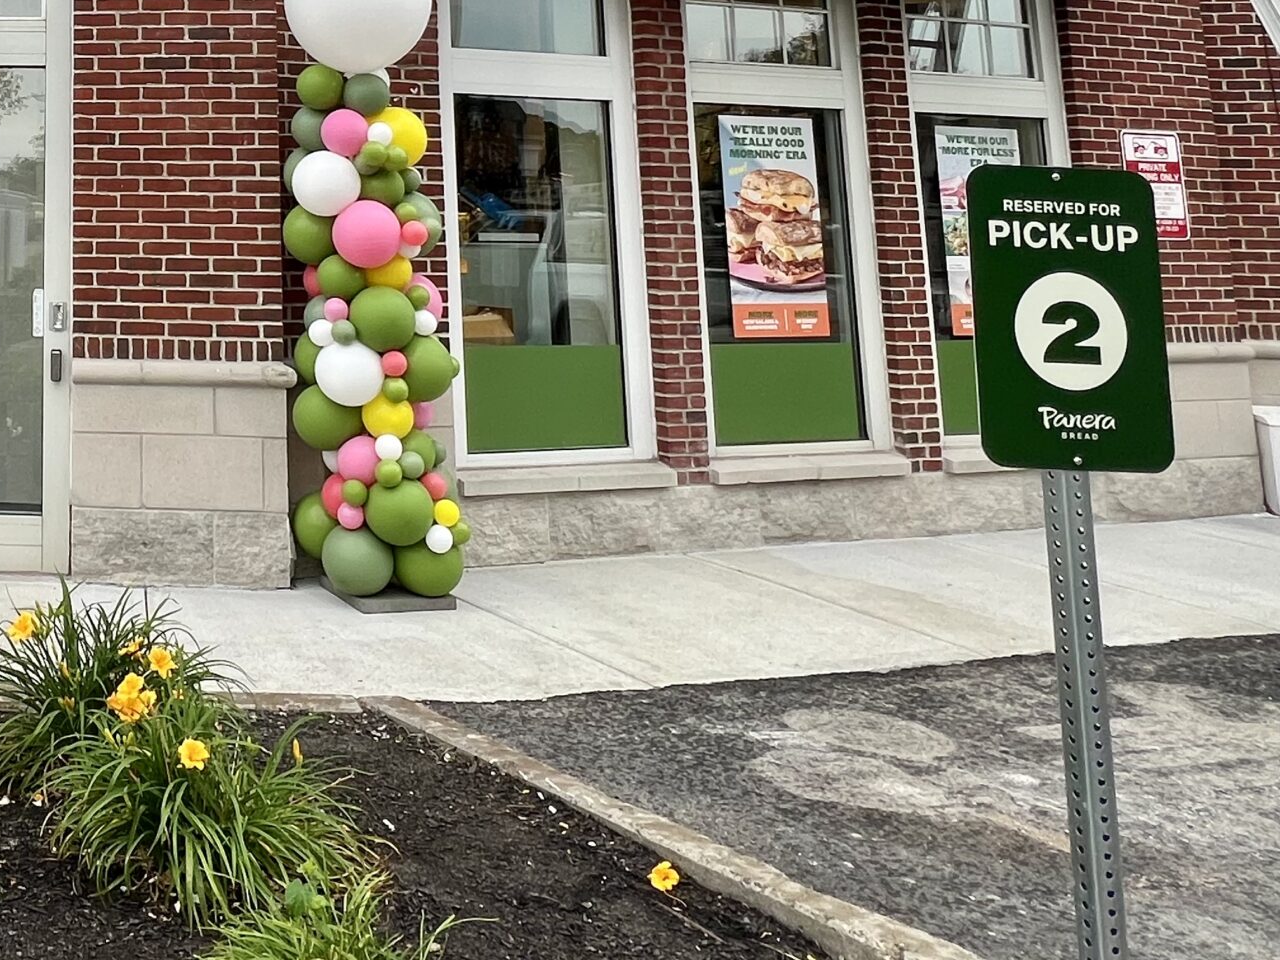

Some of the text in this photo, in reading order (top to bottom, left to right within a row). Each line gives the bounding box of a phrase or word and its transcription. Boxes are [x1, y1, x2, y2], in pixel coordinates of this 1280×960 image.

[730, 124, 802, 136] WE'RE IN OUR
[775, 138, 805, 148] GOOD
[945, 135, 1009, 145] WE'RE IN OUR
[786, 150, 808, 160] ERA
[971, 147, 990, 156] FOR
[1159, 173, 1179, 181] ONLY
[1002, 198, 1121, 217] RESERVED FOR
[988, 219, 1139, 252] PICK-UP
[1042, 300, 1102, 366] 2
[1037, 405, 1117, 430] Panera
[1061, 432, 1099, 441] BREAD
